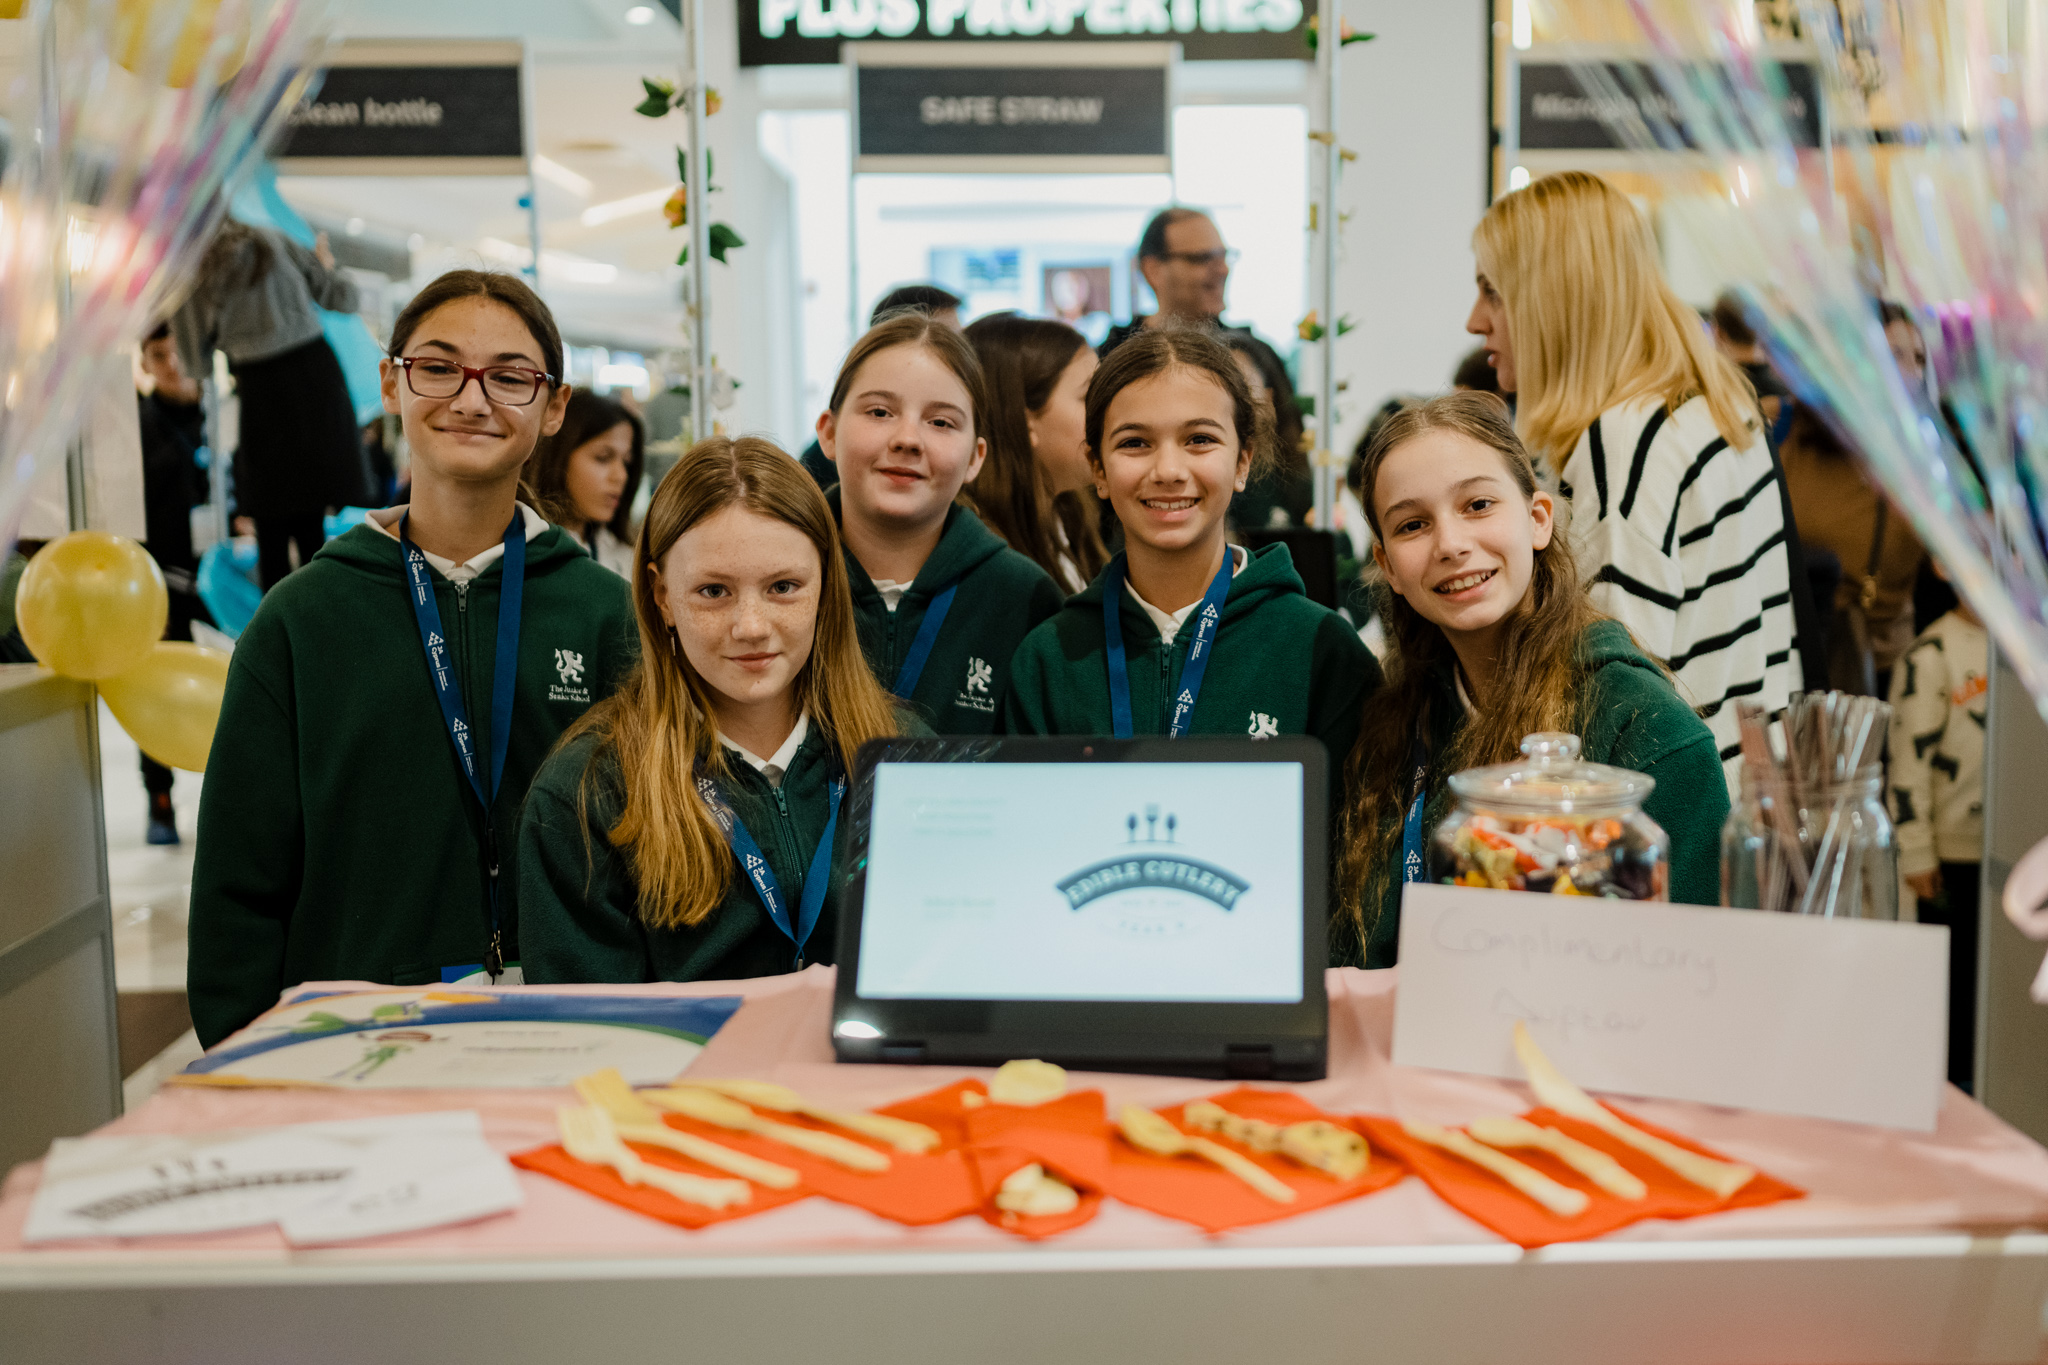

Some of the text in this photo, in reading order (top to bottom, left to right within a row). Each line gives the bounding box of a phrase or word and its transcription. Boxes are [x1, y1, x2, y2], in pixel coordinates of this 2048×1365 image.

[759, 0, 1304, 38] PLUS PROPERTIES
[364, 96, 443, 126] bottle
[921, 96, 1104, 125] SAFE STRAW
[1065, 859, 1241, 906] EDIBLE CUTLERY
